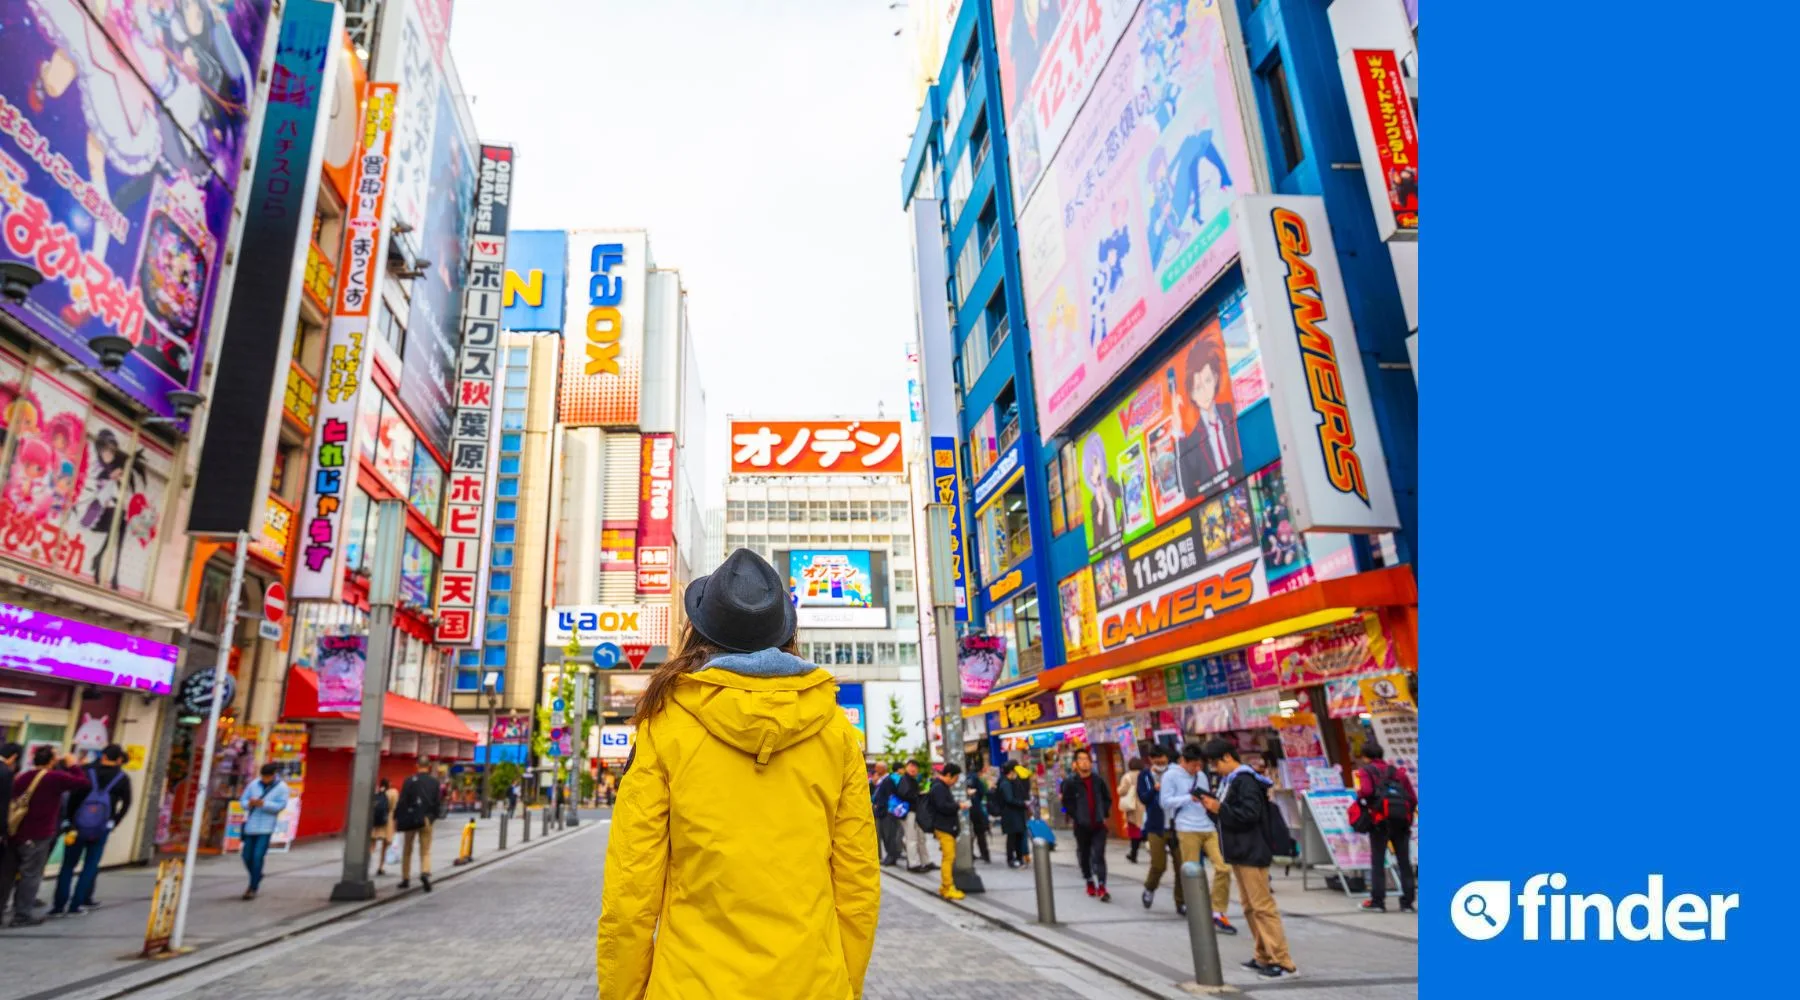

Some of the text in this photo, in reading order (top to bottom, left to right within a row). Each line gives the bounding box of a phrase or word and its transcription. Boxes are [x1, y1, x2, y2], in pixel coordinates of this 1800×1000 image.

[1271, 207, 1371, 509] GAMERS
[733, 421, 900, 467] オノデン
[651, 480, 672, 519] Free
[804, 566, 857, 578] オノデン
[1133, 543, 1179, 589] 11.30
[1101, 558, 1257, 650] GAMERS
